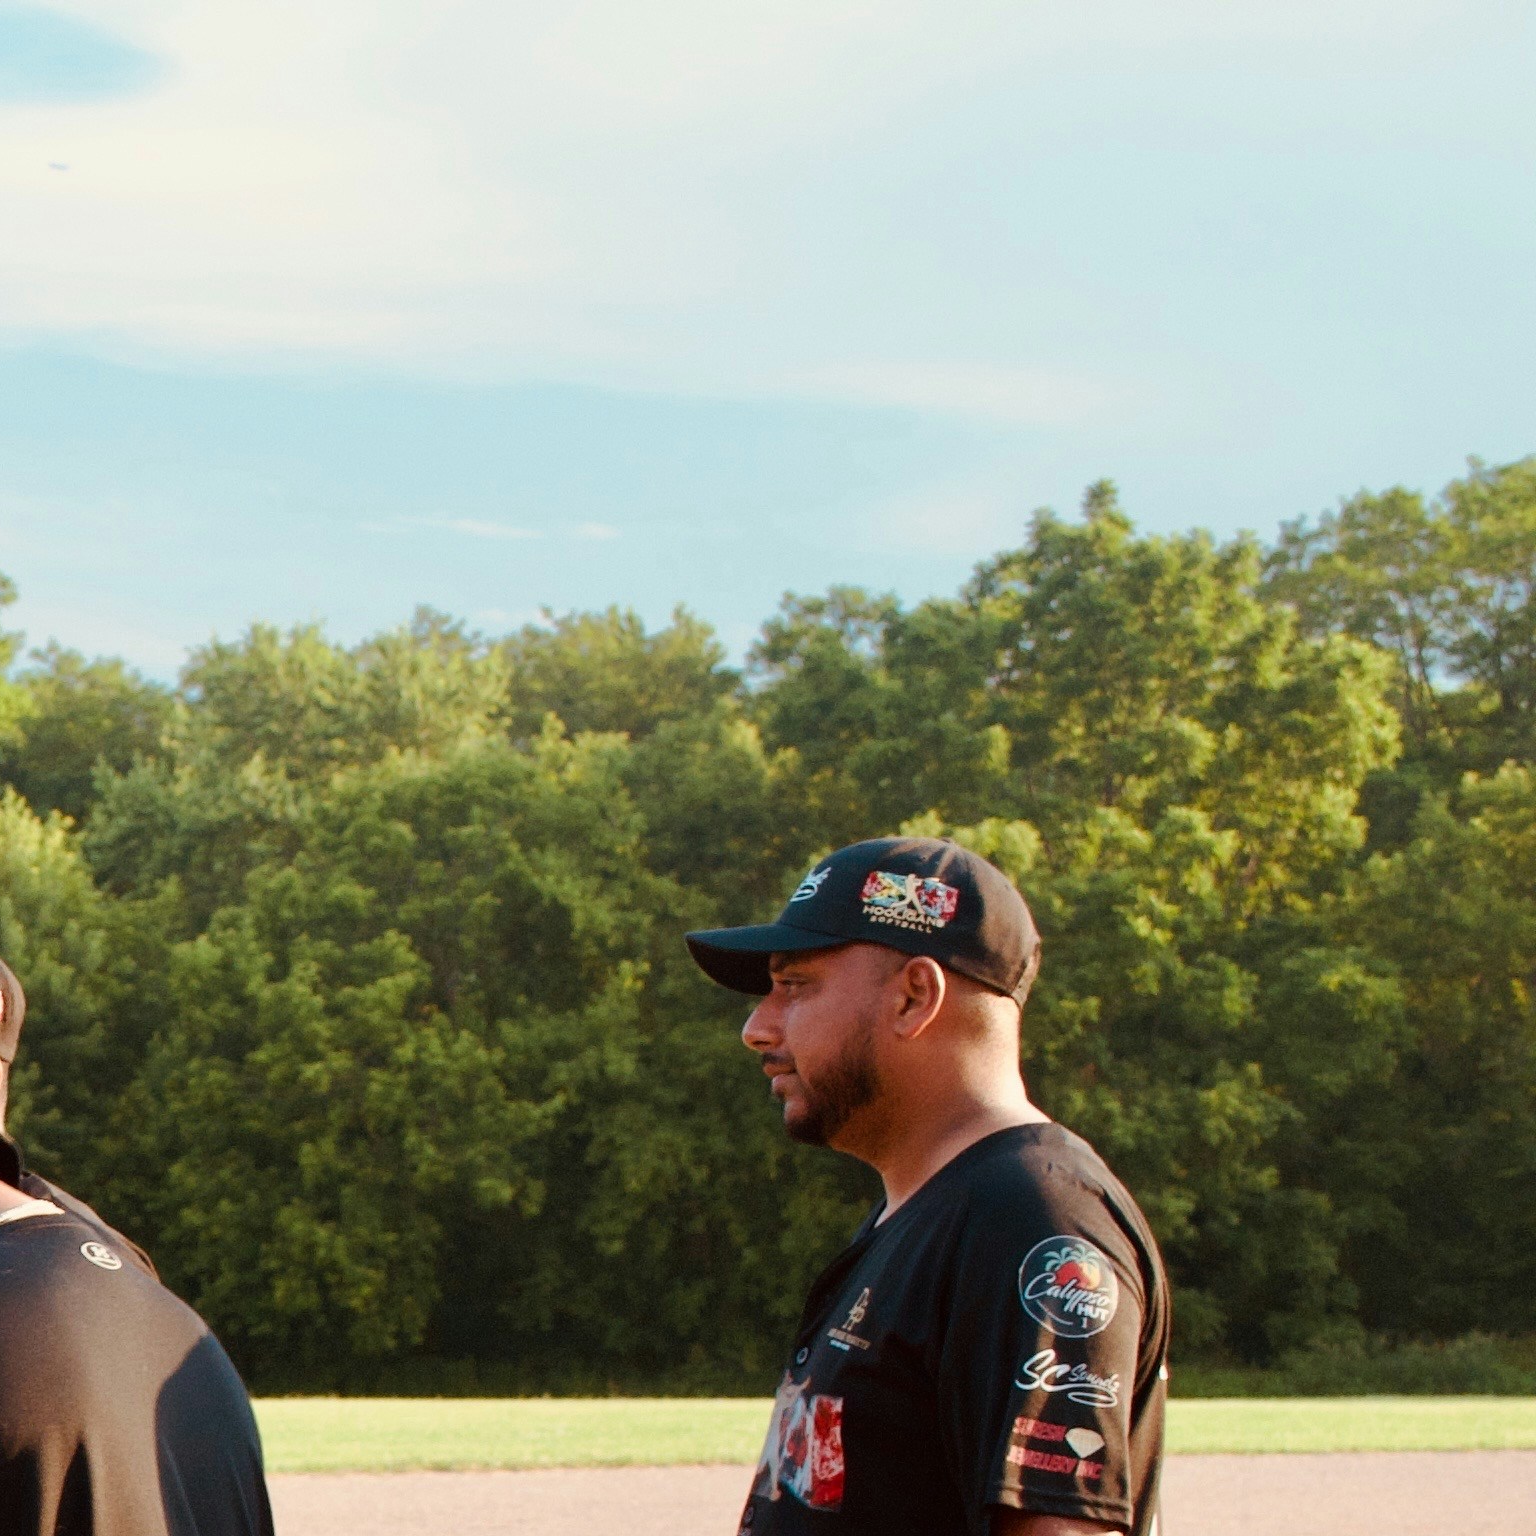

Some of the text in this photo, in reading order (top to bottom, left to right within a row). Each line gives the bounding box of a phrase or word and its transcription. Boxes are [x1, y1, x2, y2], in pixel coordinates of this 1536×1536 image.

[862, 905, 946, 929] HOOLIGANS
[870, 916, 933, 934] SOFTBALL
[1024, 1272, 1110, 1312] Calypso
[1076, 1302, 1109, 1321] HUT
